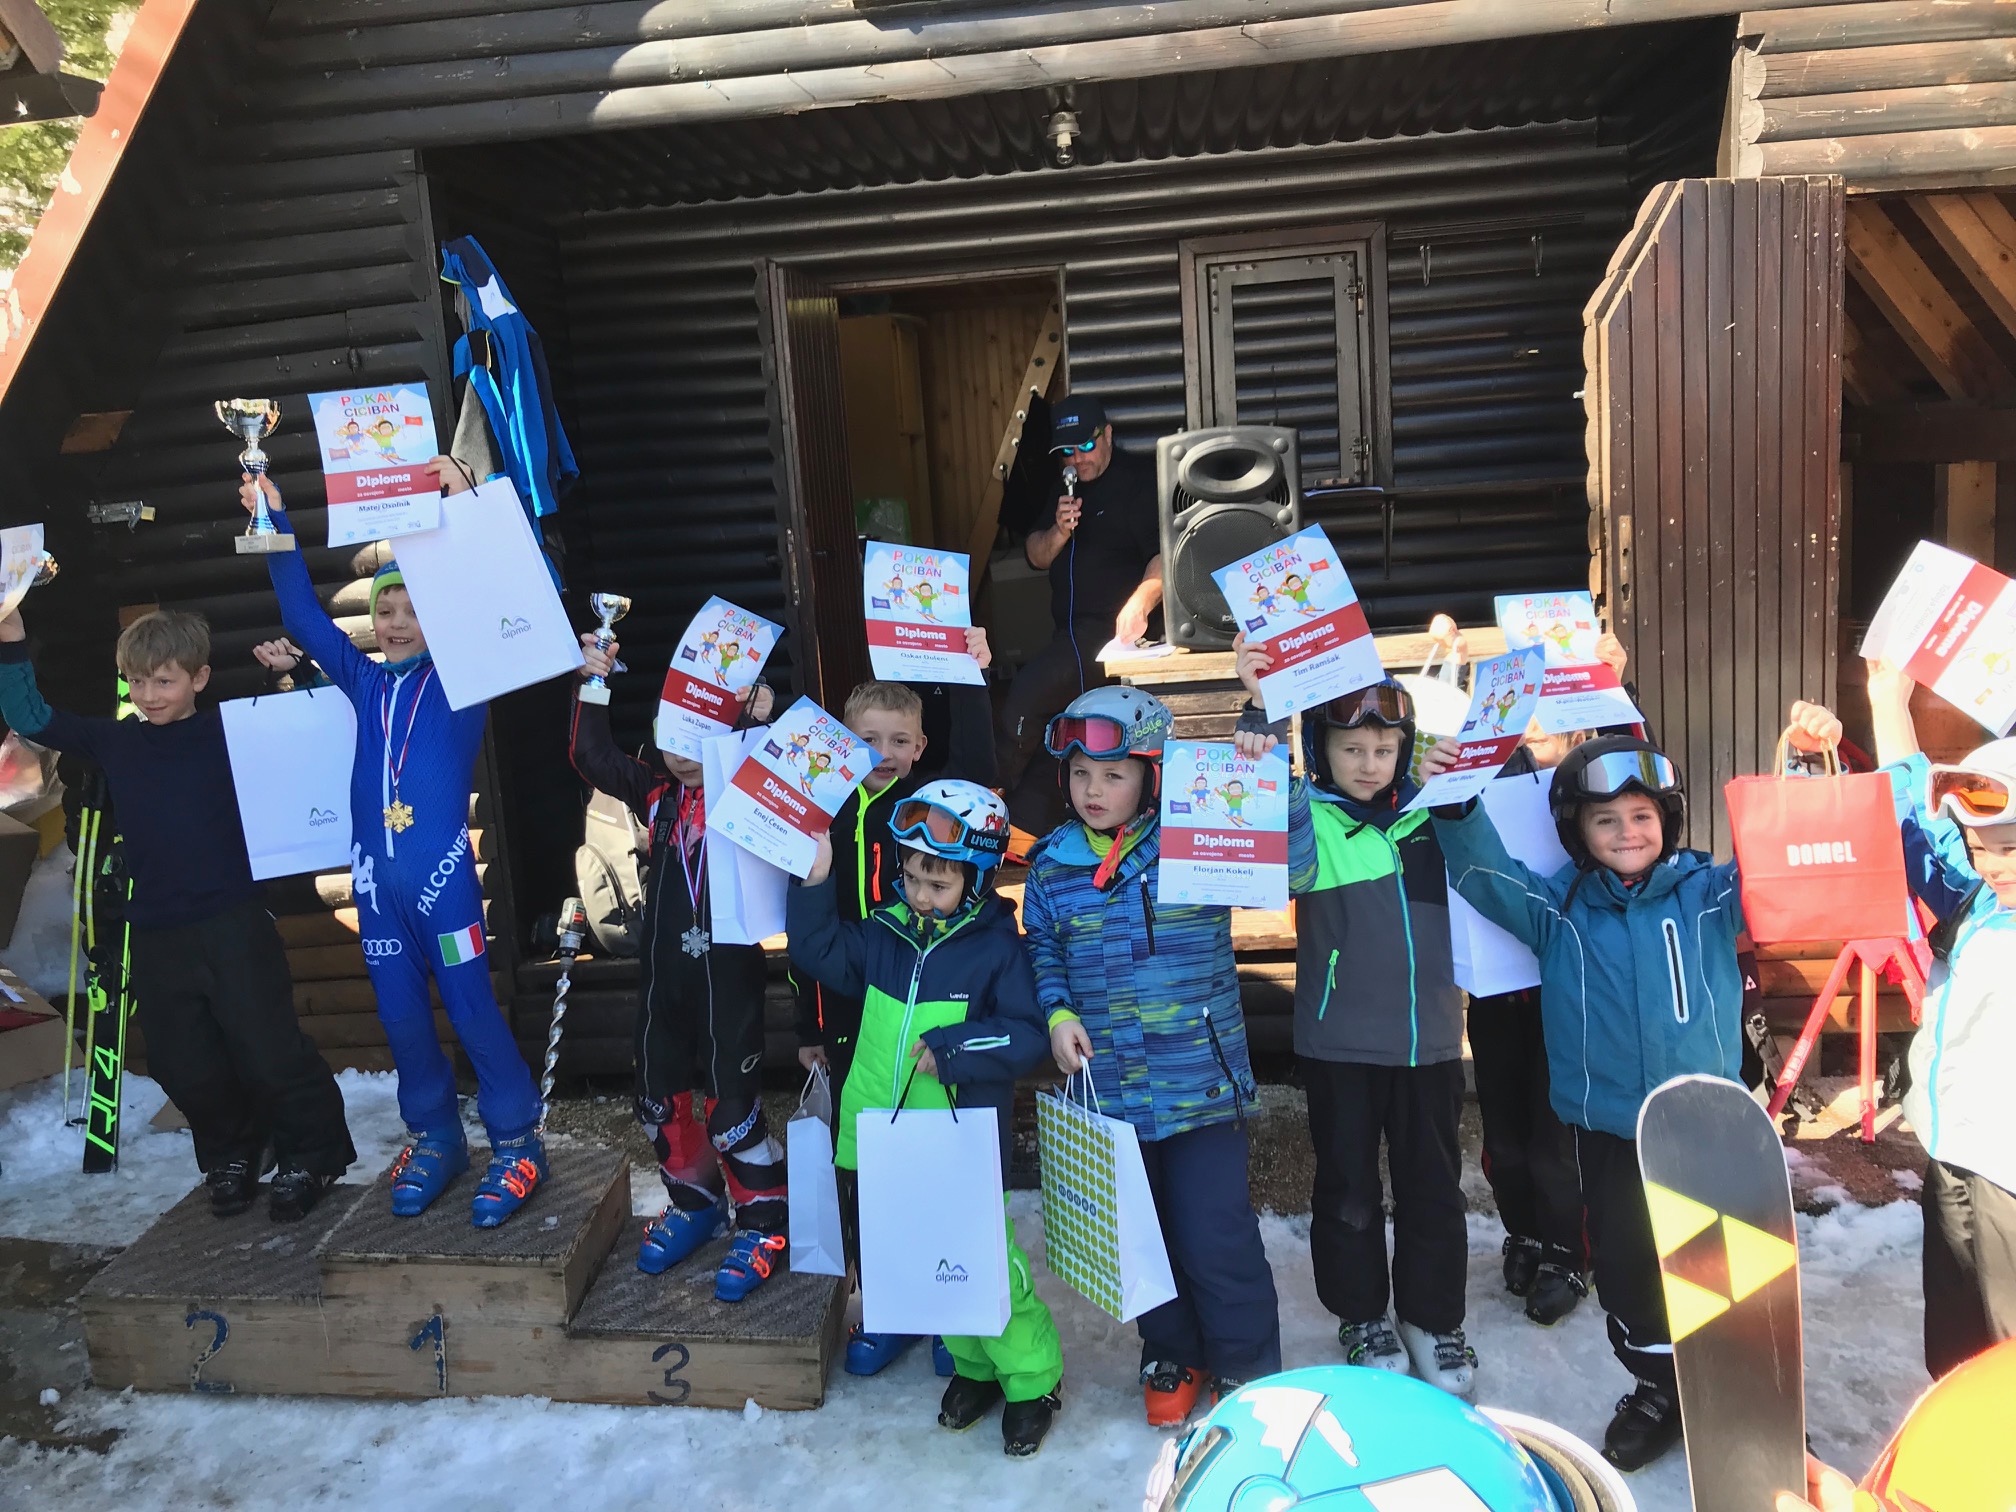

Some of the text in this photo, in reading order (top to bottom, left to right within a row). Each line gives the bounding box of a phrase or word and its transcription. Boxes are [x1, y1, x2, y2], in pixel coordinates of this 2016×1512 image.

[341, 391, 395, 406] POKAL
[345, 404, 400, 417] CICIBAN
[356, 473, 411, 488] Diploma
[358, 503, 380, 512] Matej
[893, 550, 941, 568] POKAL
[1241, 544, 1296, 574] POKAL
[893, 563, 942, 577] CICIBAN
[1249, 553, 1302, 584] CICIBAN
[1524, 597, 1568, 608] POKAL
[724, 609, 761, 633] POKAL
[1526, 608, 1571, 620] CICIBAN
[502, 624, 531, 639] alpmor
[717, 619, 756, 641] CICIBAN
[895, 626, 947, 640] Diploma
[1278, 623, 1335, 653] Diploma
[1324, 637, 1340, 647] mesto
[1293, 653, 1341, 677] Tim Ramšak
[1492, 655, 1525, 675] POKAL
[1491, 669, 1526, 687] CICIBAN
[685, 681, 724, 706] Diploma
[682, 714, 695, 724] Luka
[808, 725, 851, 759] CICIBAN
[816, 716, 858, 751] POKAL
[1196, 748, 1253, 761] POKA
[1460, 745, 1499, 759] Diploma
[1196, 761, 1255, 773] CICIBAN
[763, 777, 808, 816] Diploma
[309, 816, 338, 827] alpmor
[753, 807, 770, 823] Enej
[768, 818, 788, 835] Česen
[970, 834, 999, 850] uvex
[1193, 833, 1255, 848] Diploma
[417, 822, 469, 917] FALCONERI
[1193, 865, 1254, 876] Florjan Kokelj
[86, 1044, 120, 1155] RC4
[936, 1271, 969, 1284] alpmor
[185, 1310, 235, 1393] 2
[409, 1313, 448, 1395] 1
[647, 1343, 692, 1403] 3
